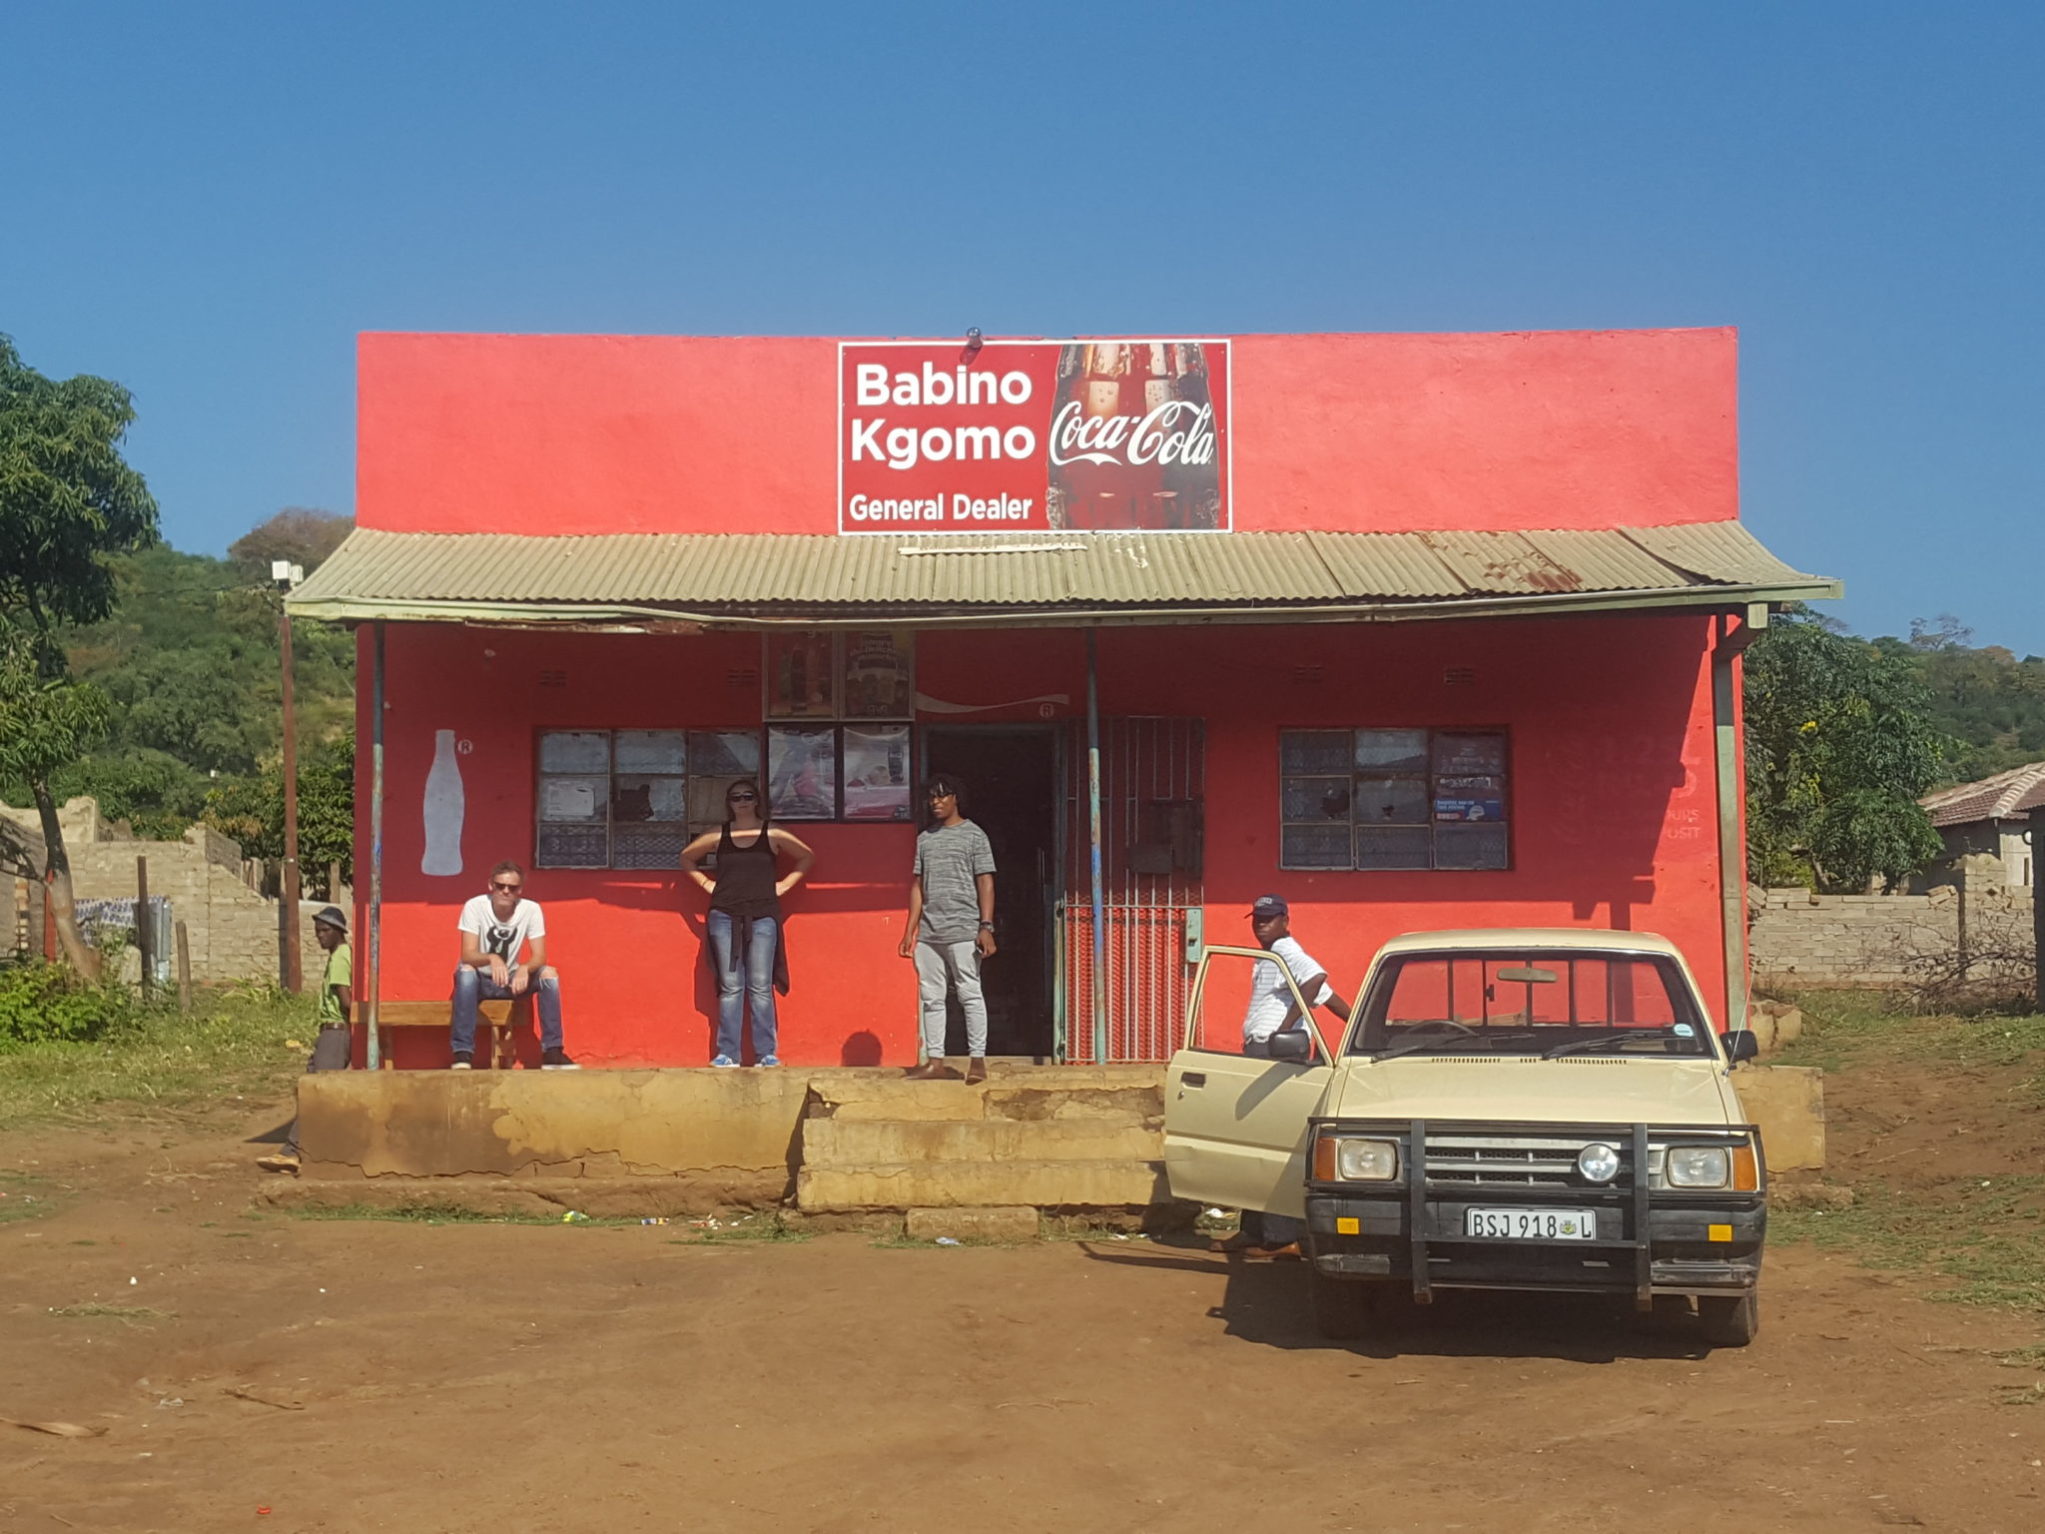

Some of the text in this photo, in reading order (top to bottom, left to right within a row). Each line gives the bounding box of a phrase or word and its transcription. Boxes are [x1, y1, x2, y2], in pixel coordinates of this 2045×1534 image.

[857, 361, 1032, 406] Babino
[851, 418, 1036, 470] Kgomo
[1049, 400, 1214, 466] Coca-Cola
[849, 492, 1032, 521] General Dealer
[1473, 1213, 1592, 1239] BSJ 918 L
